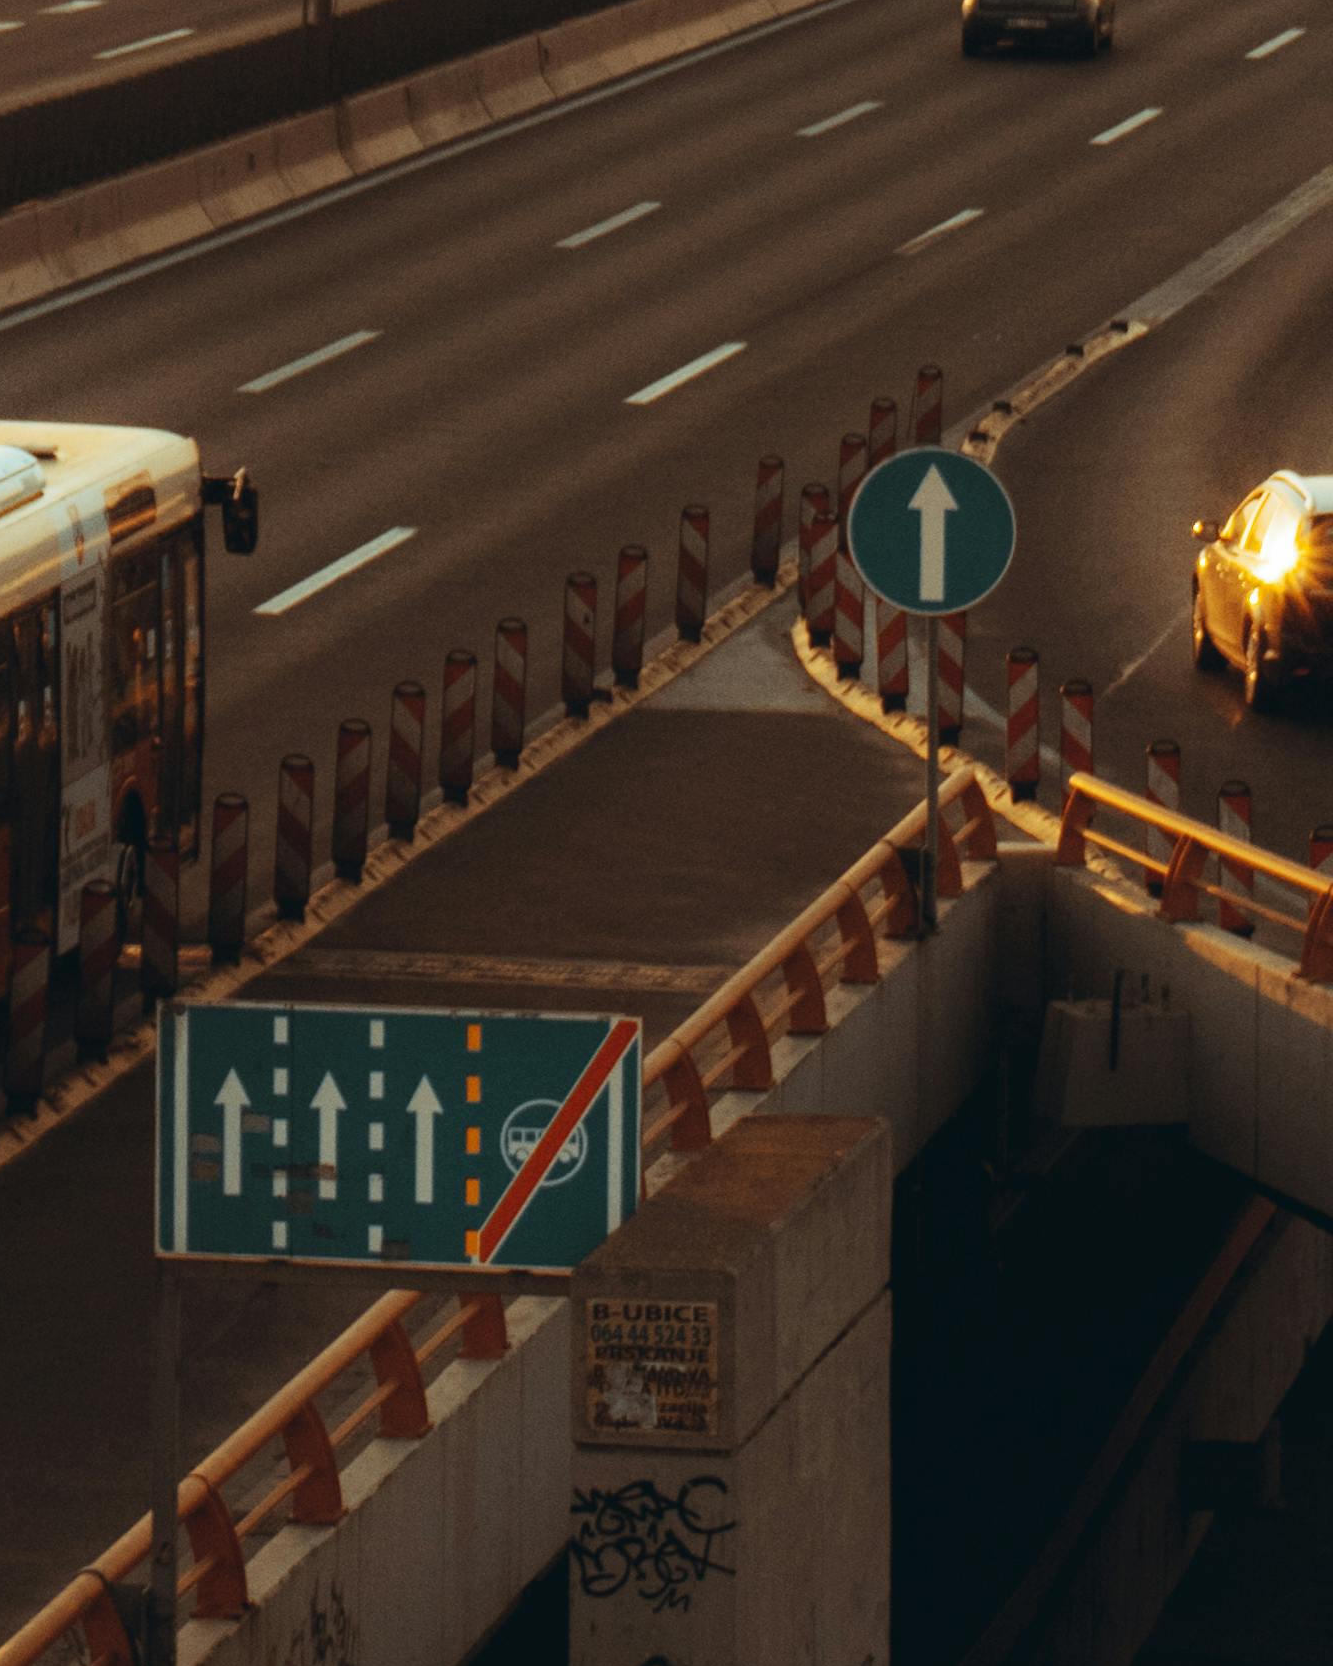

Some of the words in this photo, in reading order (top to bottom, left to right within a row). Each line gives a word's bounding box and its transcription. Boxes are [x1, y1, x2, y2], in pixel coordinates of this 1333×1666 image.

[593, 1303, 708, 1323] B-UBICE
[591, 1323, 623, 1343] 064
[628, 1324, 649, 1344] 44
[654, 1324, 686, 1345] 524
[691, 1325, 712, 1346] 33
